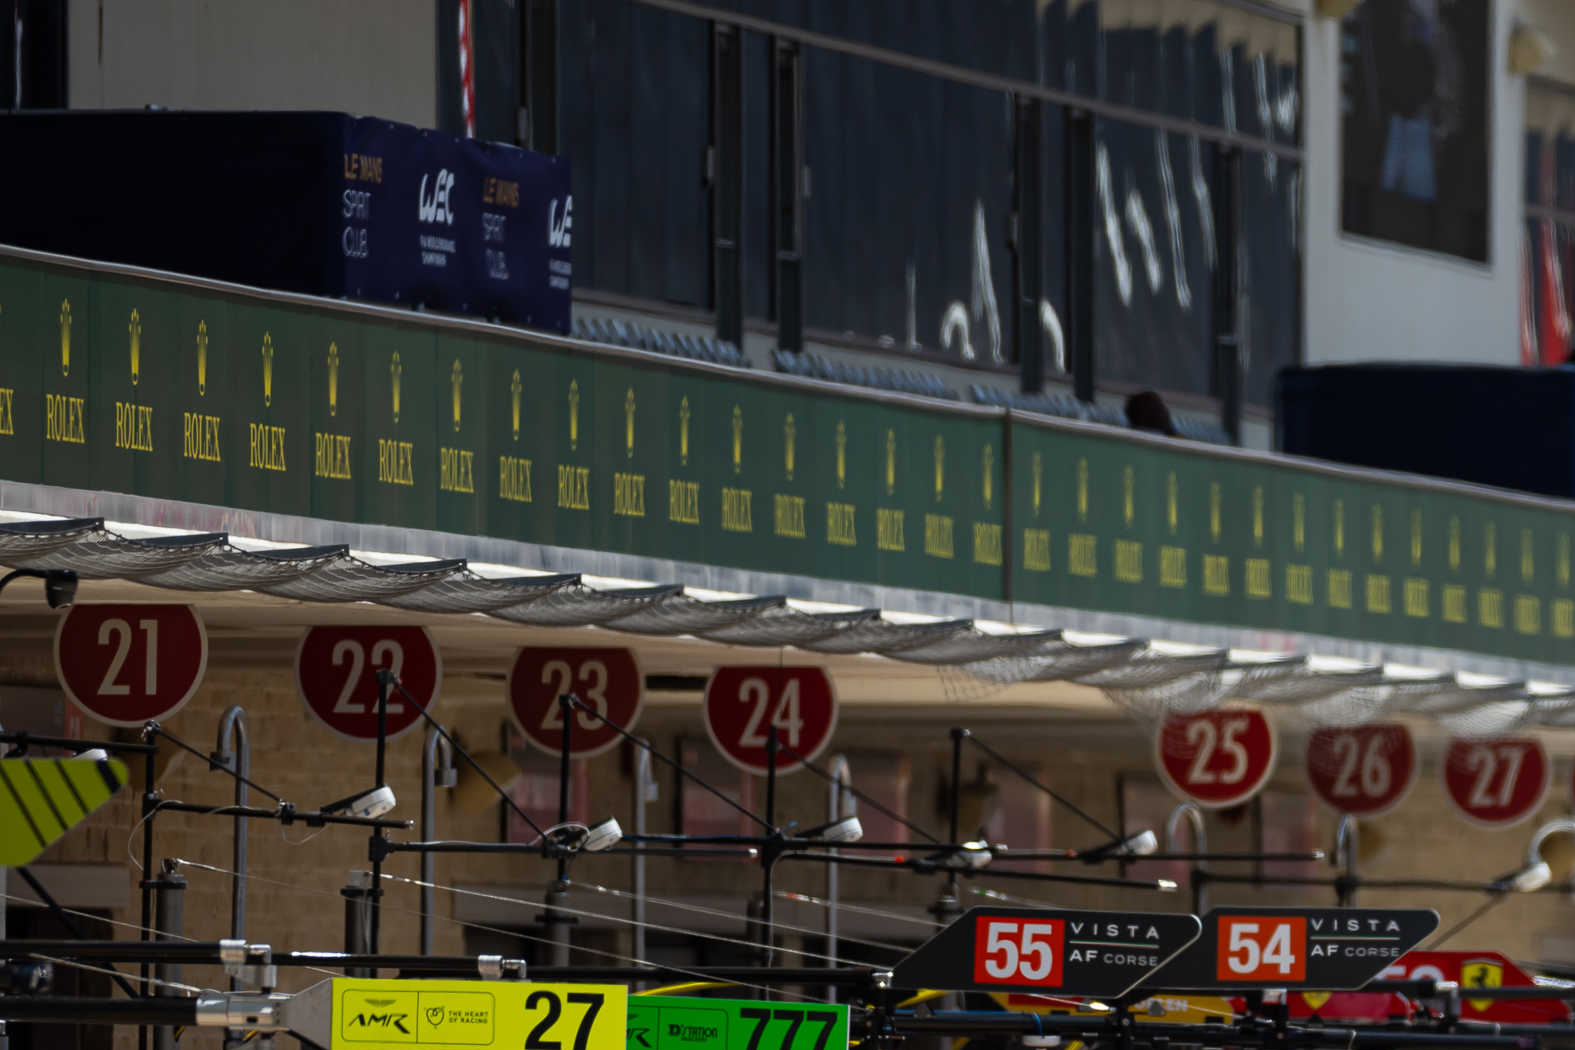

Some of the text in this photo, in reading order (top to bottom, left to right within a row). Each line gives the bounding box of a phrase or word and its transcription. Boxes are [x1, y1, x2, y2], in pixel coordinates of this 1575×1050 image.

[418, 168, 455, 226] WEC
[45, 393, 86, 444] ROLEX
[115, 401, 154, 452] ROLEX
[183, 411, 222, 463] ROLEX
[249, 422, 287, 472] ROLEX
[314, 432, 352, 480] ROLEX
[378, 438, 414, 486] ROLEX
[440, 447, 475, 493] ROLEX
[499, 456, 532, 502] ROLEX
[558, 465, 589, 510] ROLEX
[614, 472, 645, 517] ROLEX
[669, 480, 699, 524] ROLEX
[722, 488, 752, 531] ROLEX
[97, 618, 159, 696] 21
[331, 639, 405, 715] 22
[540, 658, 608, 731] 23
[738, 677, 804, 748] 24
[1185, 717, 1249, 785] 25
[1333, 734, 1392, 798] 26
[1467, 747, 1525, 807] 27
[1069, 921, 1161, 940] VISTA
[1227, 922, 1296, 975] 54
[1310, 918, 1400, 932] VISTA
[984, 921, 1054, 981] 55
[1069, 949, 1159, 967] AF CORSE
[1310, 944, 1399, 958] AF CORSE
[348, 1013, 411, 1035] AMR
